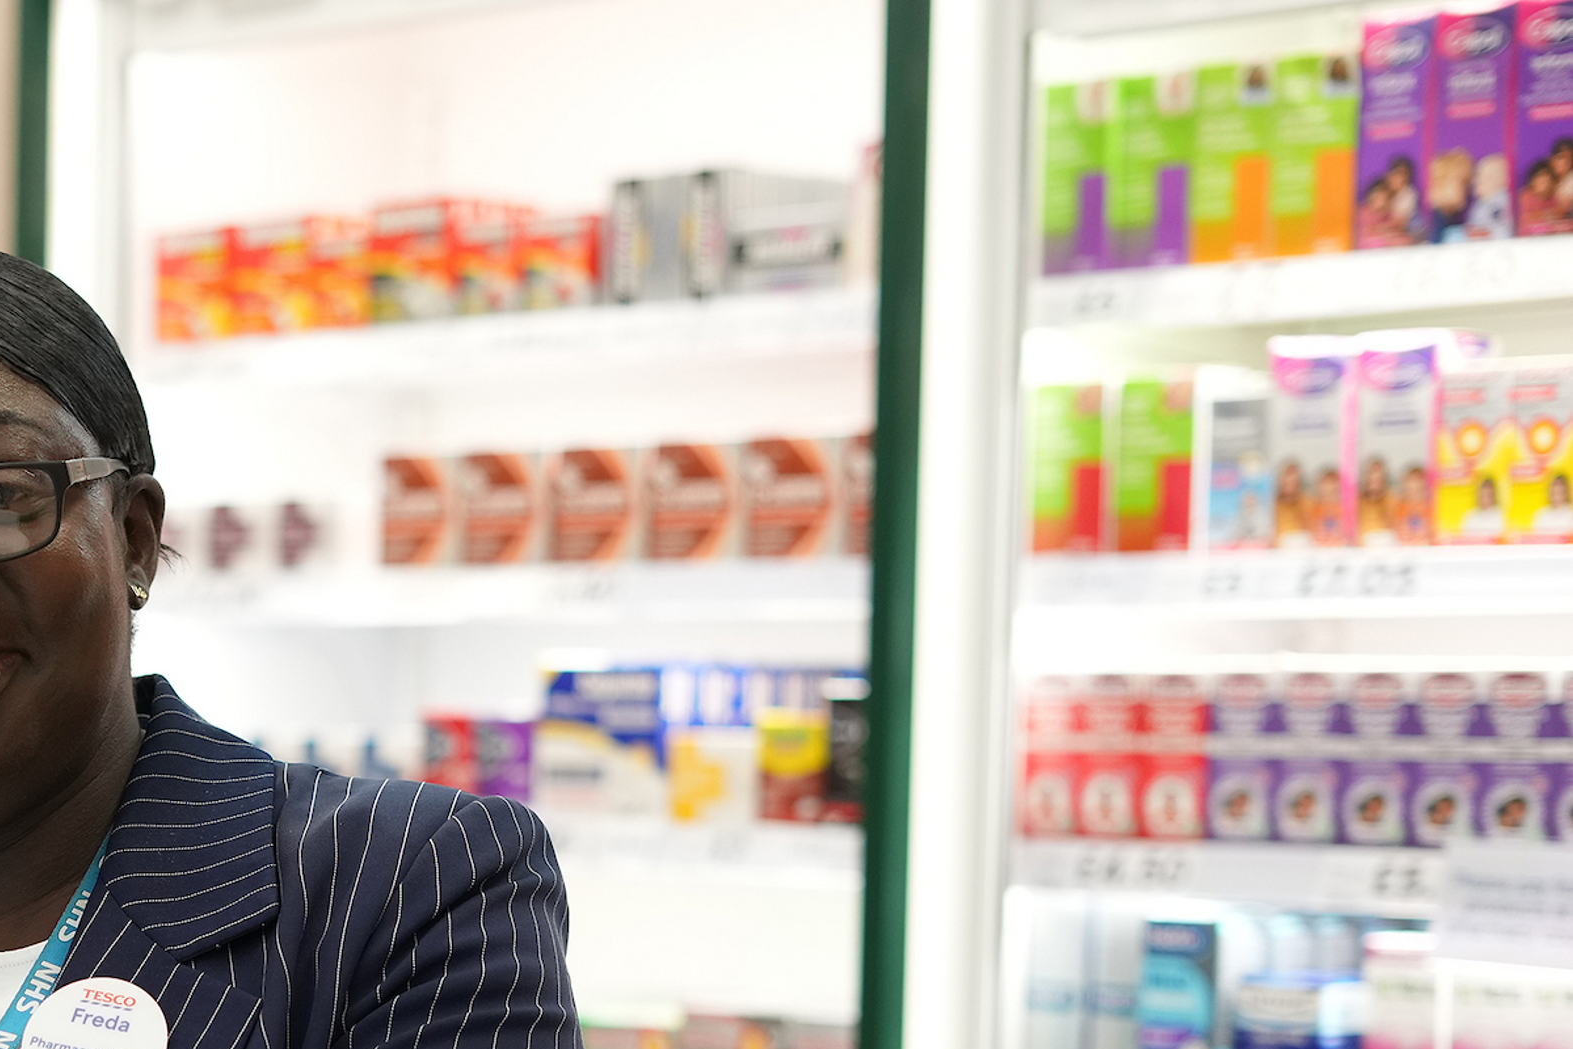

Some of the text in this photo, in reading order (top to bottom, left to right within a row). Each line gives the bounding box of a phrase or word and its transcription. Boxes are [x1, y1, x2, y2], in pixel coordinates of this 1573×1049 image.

[16, 960, 62, 1015] NHS
[83, 988, 137, 1007] TESCO
[71, 1007, 130, 1033] Freda
